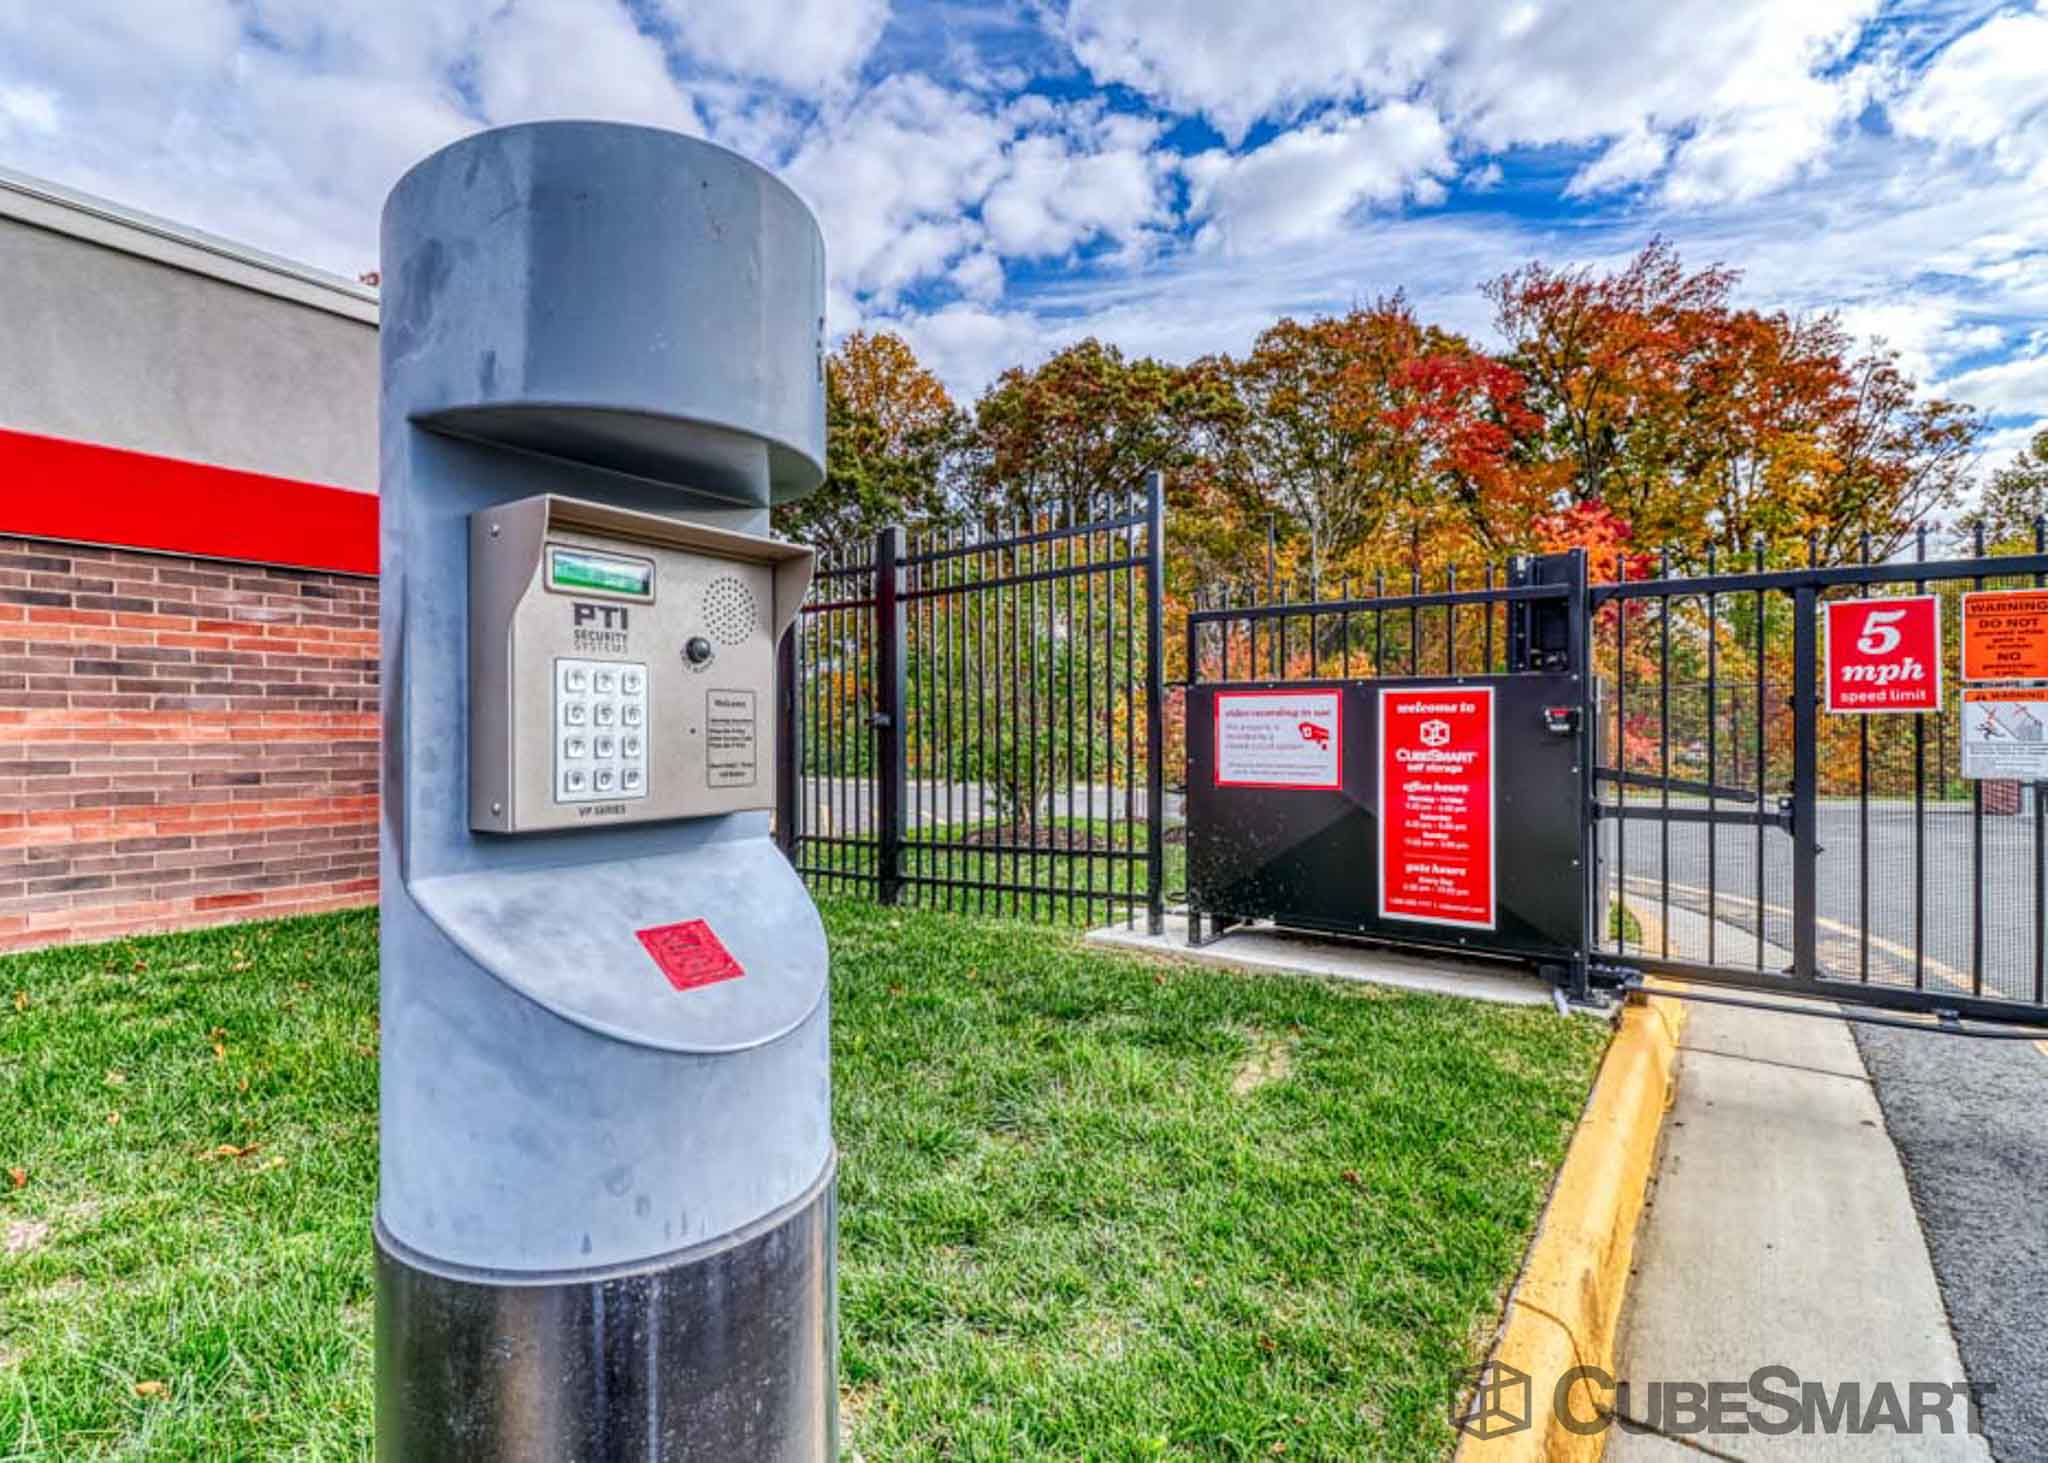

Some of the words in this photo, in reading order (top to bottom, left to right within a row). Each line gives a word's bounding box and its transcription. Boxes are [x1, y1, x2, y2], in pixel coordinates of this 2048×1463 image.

[1970, 600, 2048, 612] WARNING
[574, 603, 628, 630] PTI
[1979, 619, 2002, 629] DO
[2006, 618, 2038, 628] NOT
[574, 629, 628, 643] SECURITY
[1857, 609, 1907, 655] 5
[1997, 652, 2021, 661] NO
[1841, 657, 1925, 685] mph
[1840, 689, 1887, 704] speed
[1890, 688, 1926, 701] limit
[1397, 701, 1458, 714] welcome
[1460, 702, 1476, 714] to
